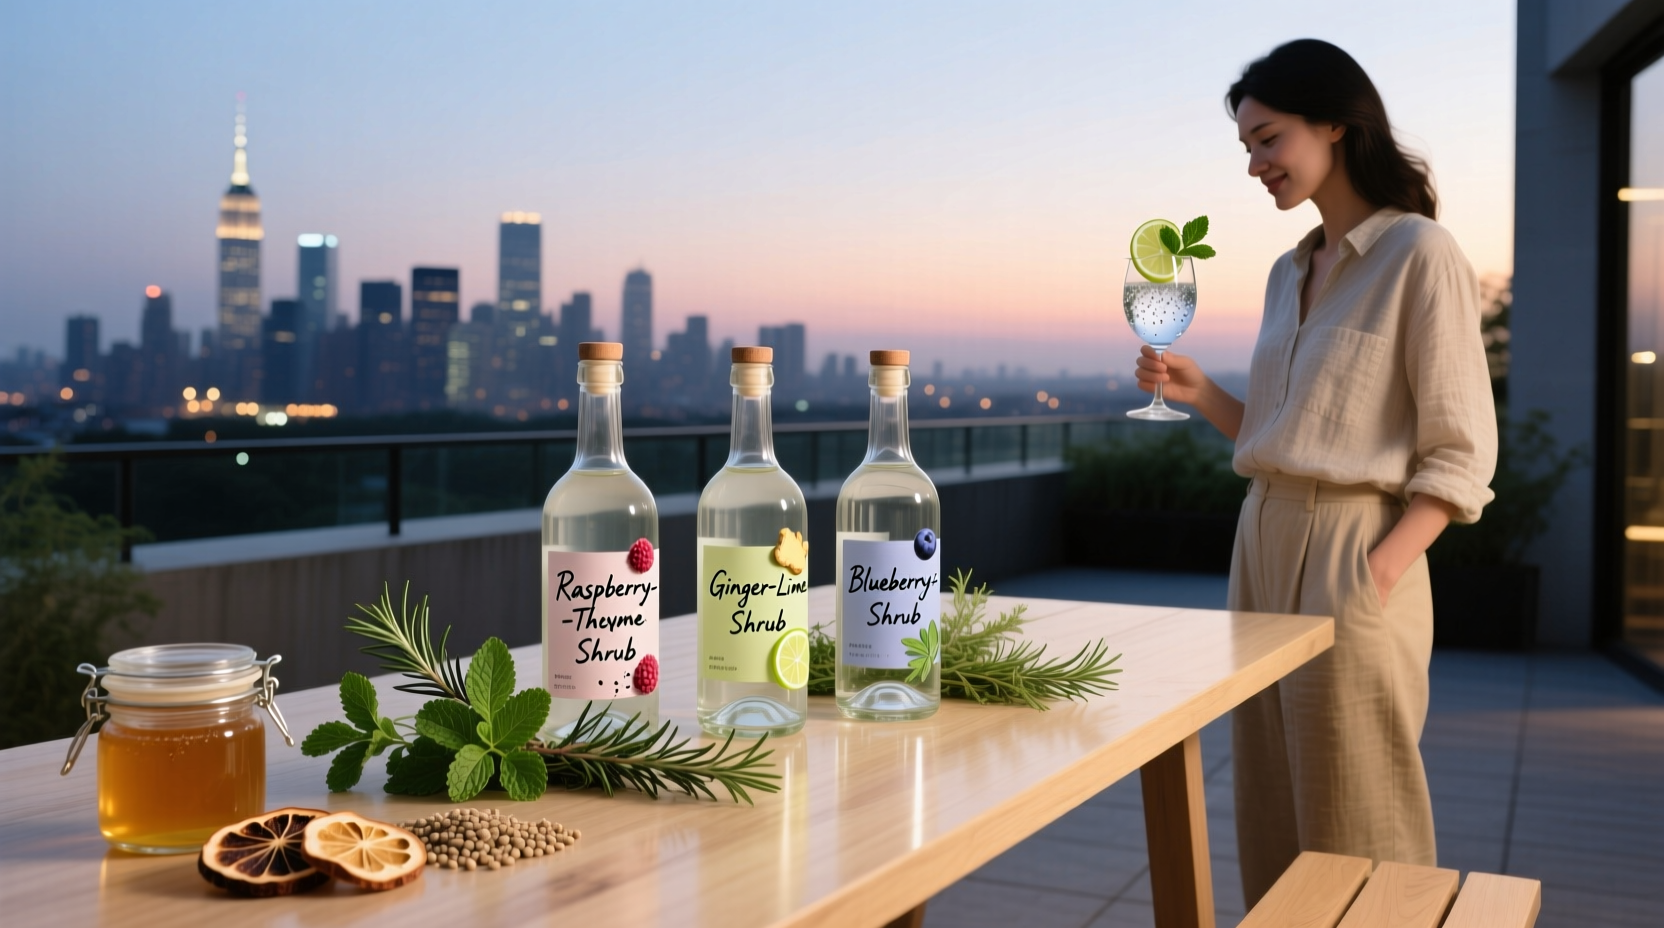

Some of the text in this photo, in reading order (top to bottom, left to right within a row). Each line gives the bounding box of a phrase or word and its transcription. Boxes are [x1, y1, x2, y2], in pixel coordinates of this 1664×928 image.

[556, 570, 658, 607] Raspberry-
[709, 569, 807, 608] Ginger-Lime
[729, 608, 786, 635] Shrub
[866, 601, 921, 626] Shrub
[575, 636, 636, 664] Shrub
